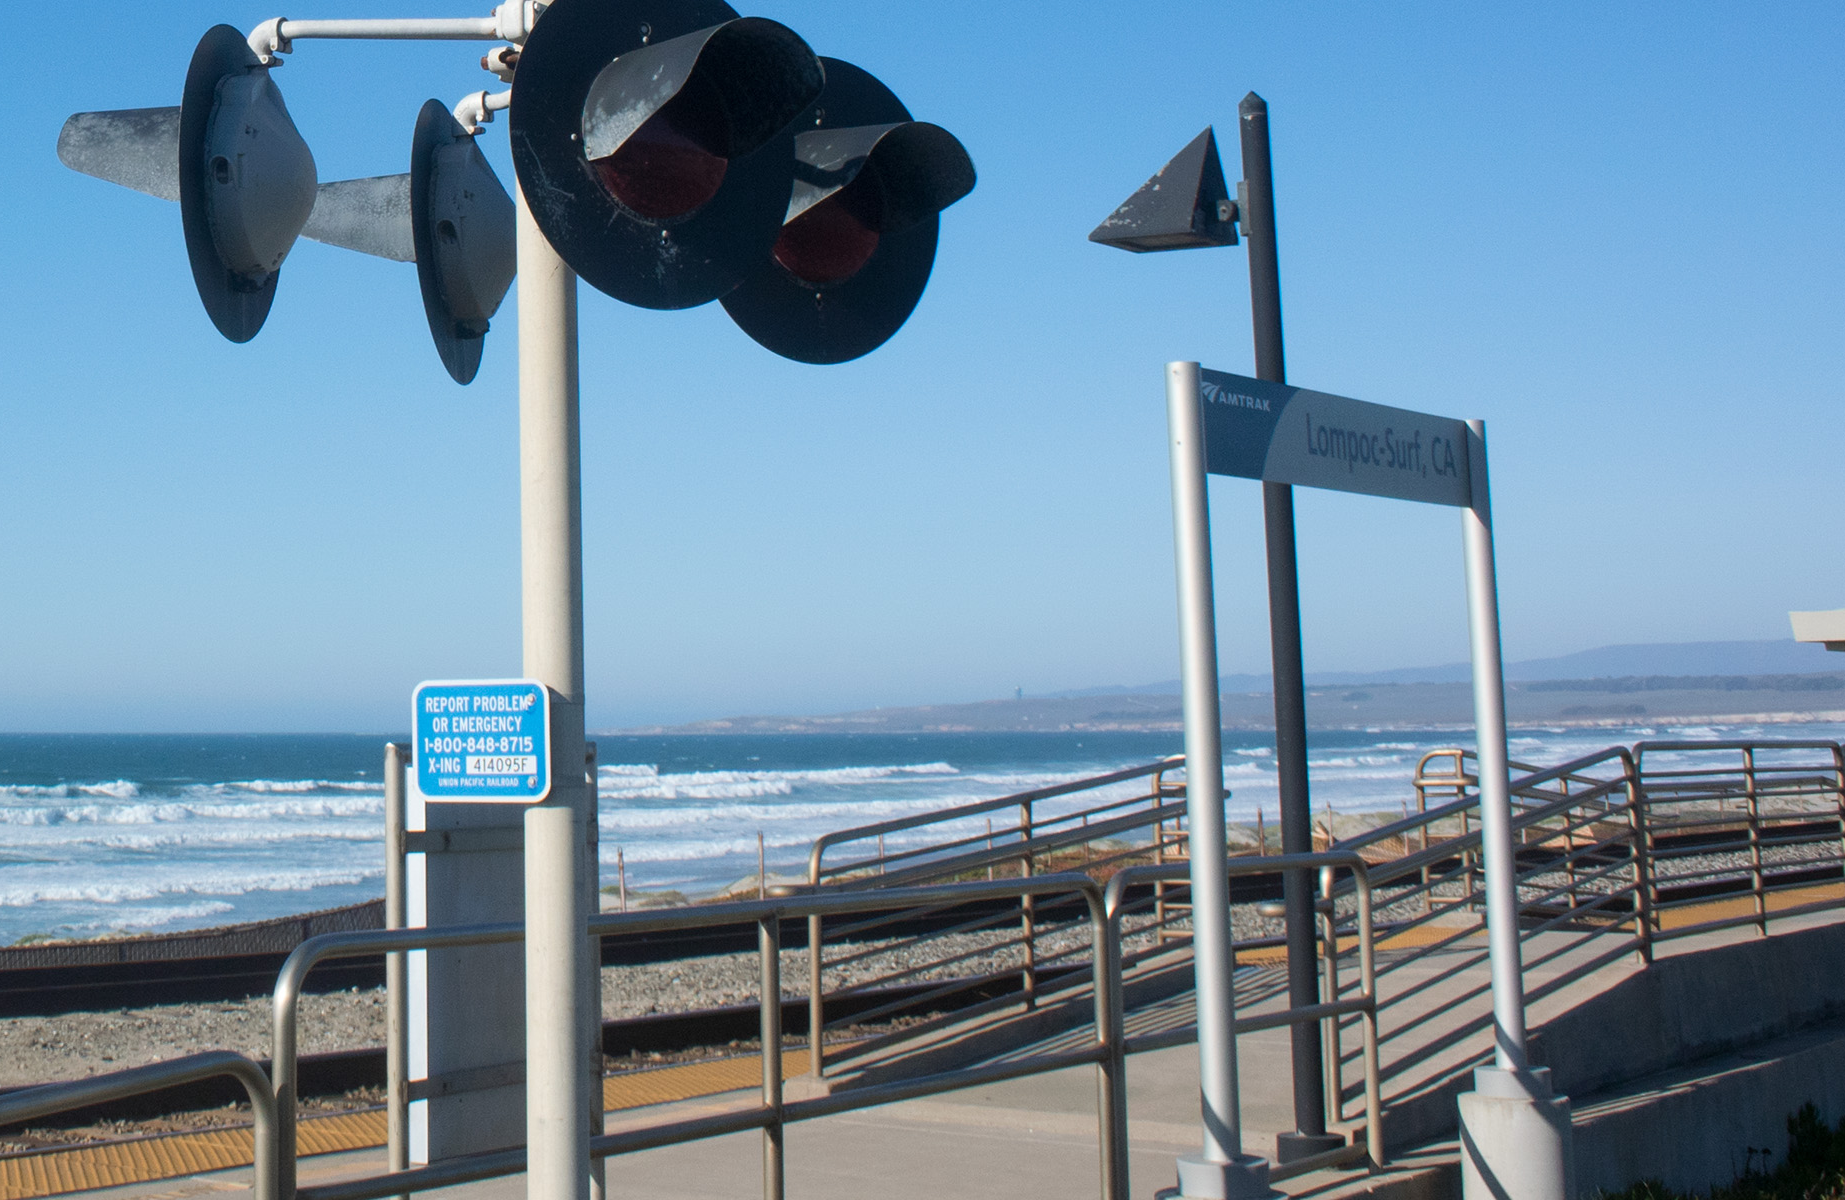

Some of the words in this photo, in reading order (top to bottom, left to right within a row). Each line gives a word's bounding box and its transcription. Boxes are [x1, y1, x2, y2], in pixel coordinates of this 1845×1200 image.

[1218, 392, 1270, 412] AMTRAK
[1306, 413, 1427, 478] Lompoc-Surf,
[1432, 436, 1456, 478] CA
[425, 696, 469, 713] REPORT
[473, 695, 529, 712] PROBLEM
[432, 717, 448, 732] OR
[452, 716, 522, 732] EMERGENCY
[424, 737, 533, 753] 1-800-848-8715
[428, 757, 461, 773] X-ING
[473, 757, 528, 773] 414095F
[438, 778, 459, 787] UNION
[460, 777, 485, 787] PACIFIC
[487, 777, 519, 787] RAILROAD
